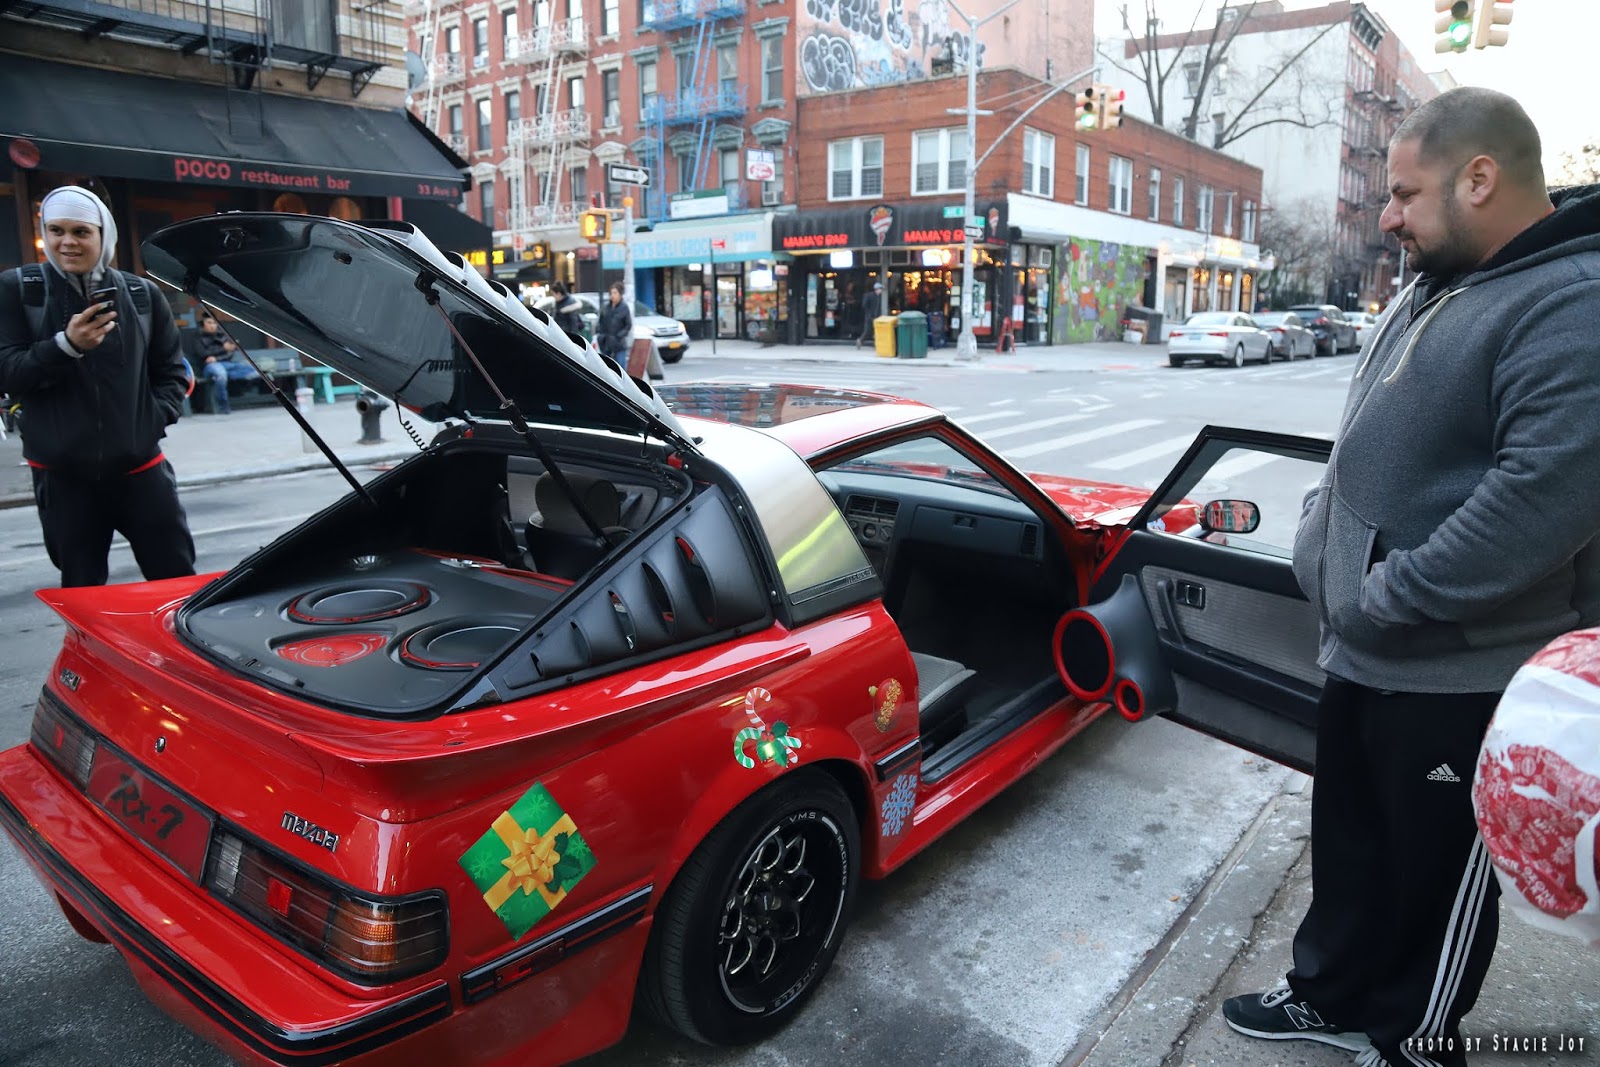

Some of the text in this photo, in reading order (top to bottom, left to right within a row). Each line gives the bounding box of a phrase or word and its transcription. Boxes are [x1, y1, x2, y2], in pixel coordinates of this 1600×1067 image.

[175, 158, 351, 190] poco restaurant bar
[783, 233, 848, 248] MAMA'S BAR
[903, 229, 952, 243] MAMA'S
[1426, 774, 1461, 782] adidas
[789, 812, 817, 822] VMS
[281, 811, 339, 852] mazda
[837, 835, 848, 886] RACING
[1283, 1001, 1325, 1029] N
